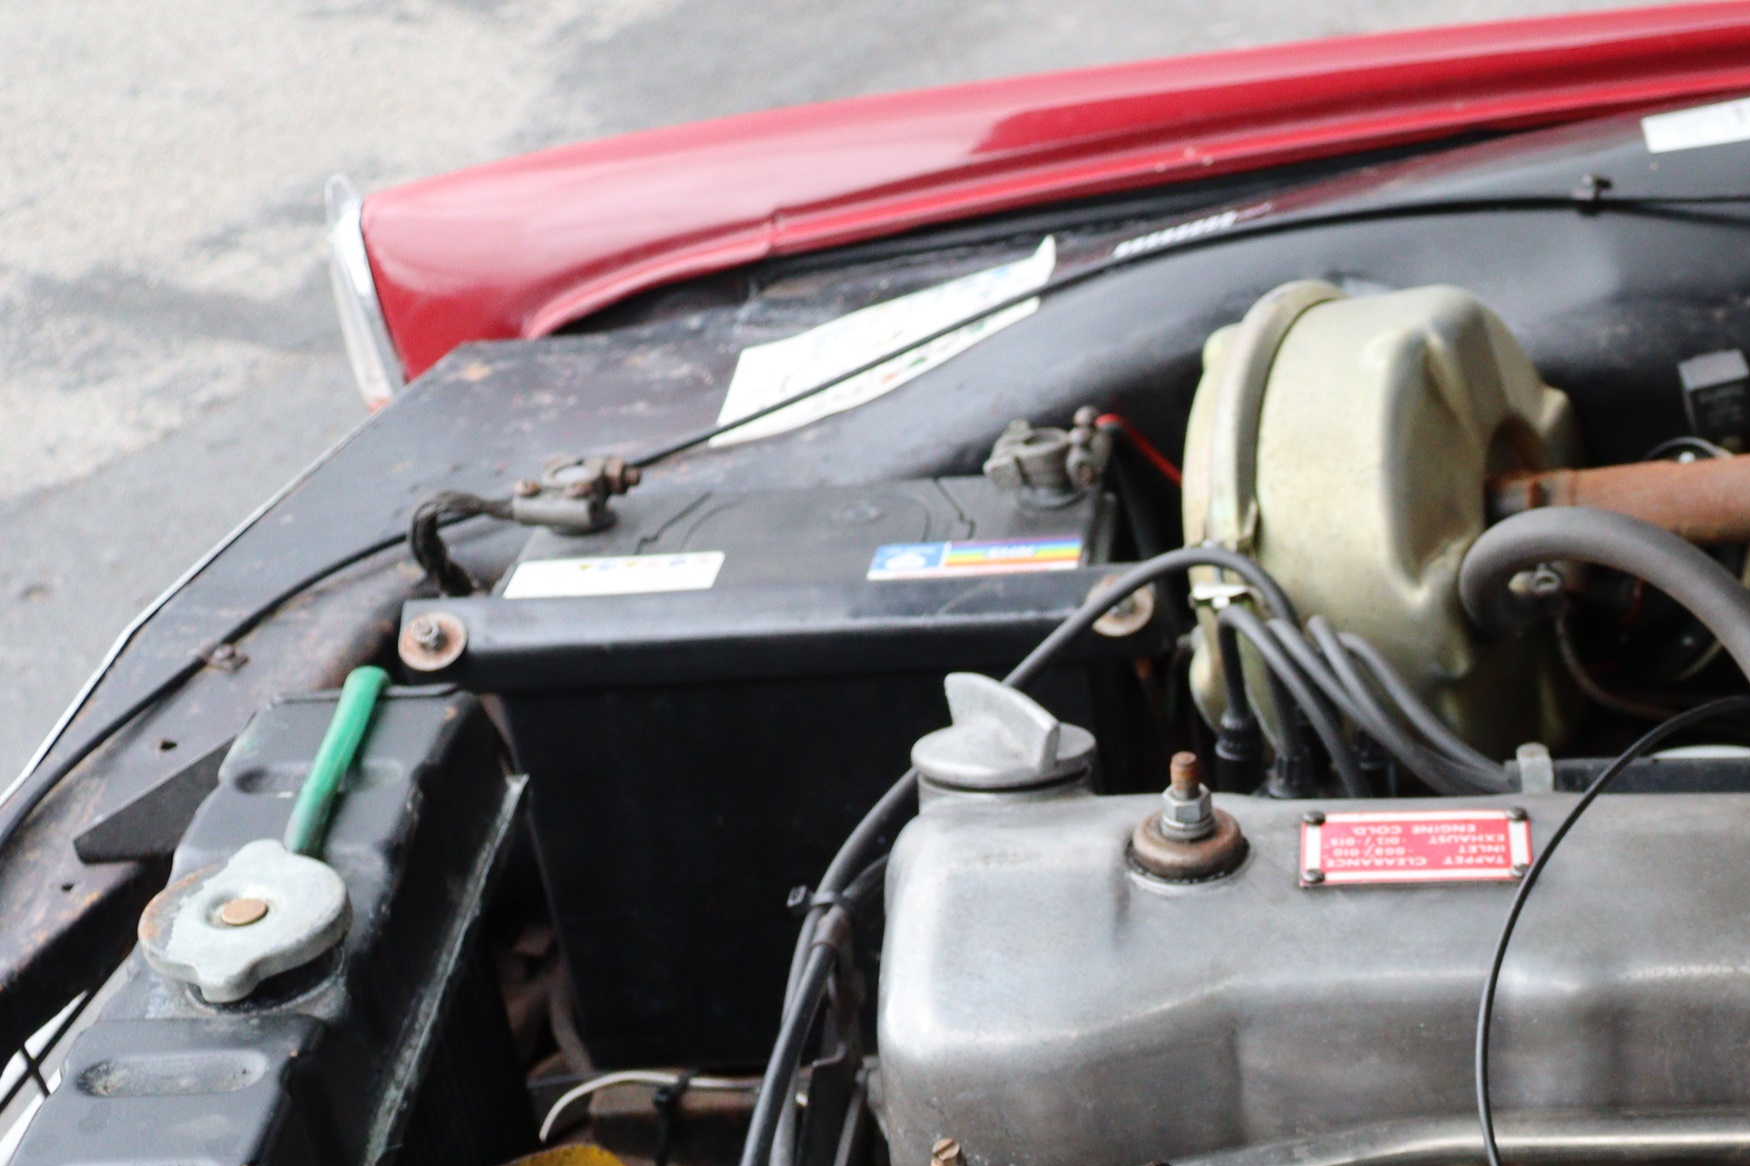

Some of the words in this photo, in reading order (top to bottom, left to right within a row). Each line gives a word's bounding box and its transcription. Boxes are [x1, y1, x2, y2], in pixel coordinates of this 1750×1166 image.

[1411, 823, 1477, 835] ENGINE
[1429, 833, 1505, 845] EXHAUST
[1458, 845, 1506, 855] INLET
[1325, 856, 1428, 868] CLEARANCE
[1444, 855, 1505, 865] TAPPET
